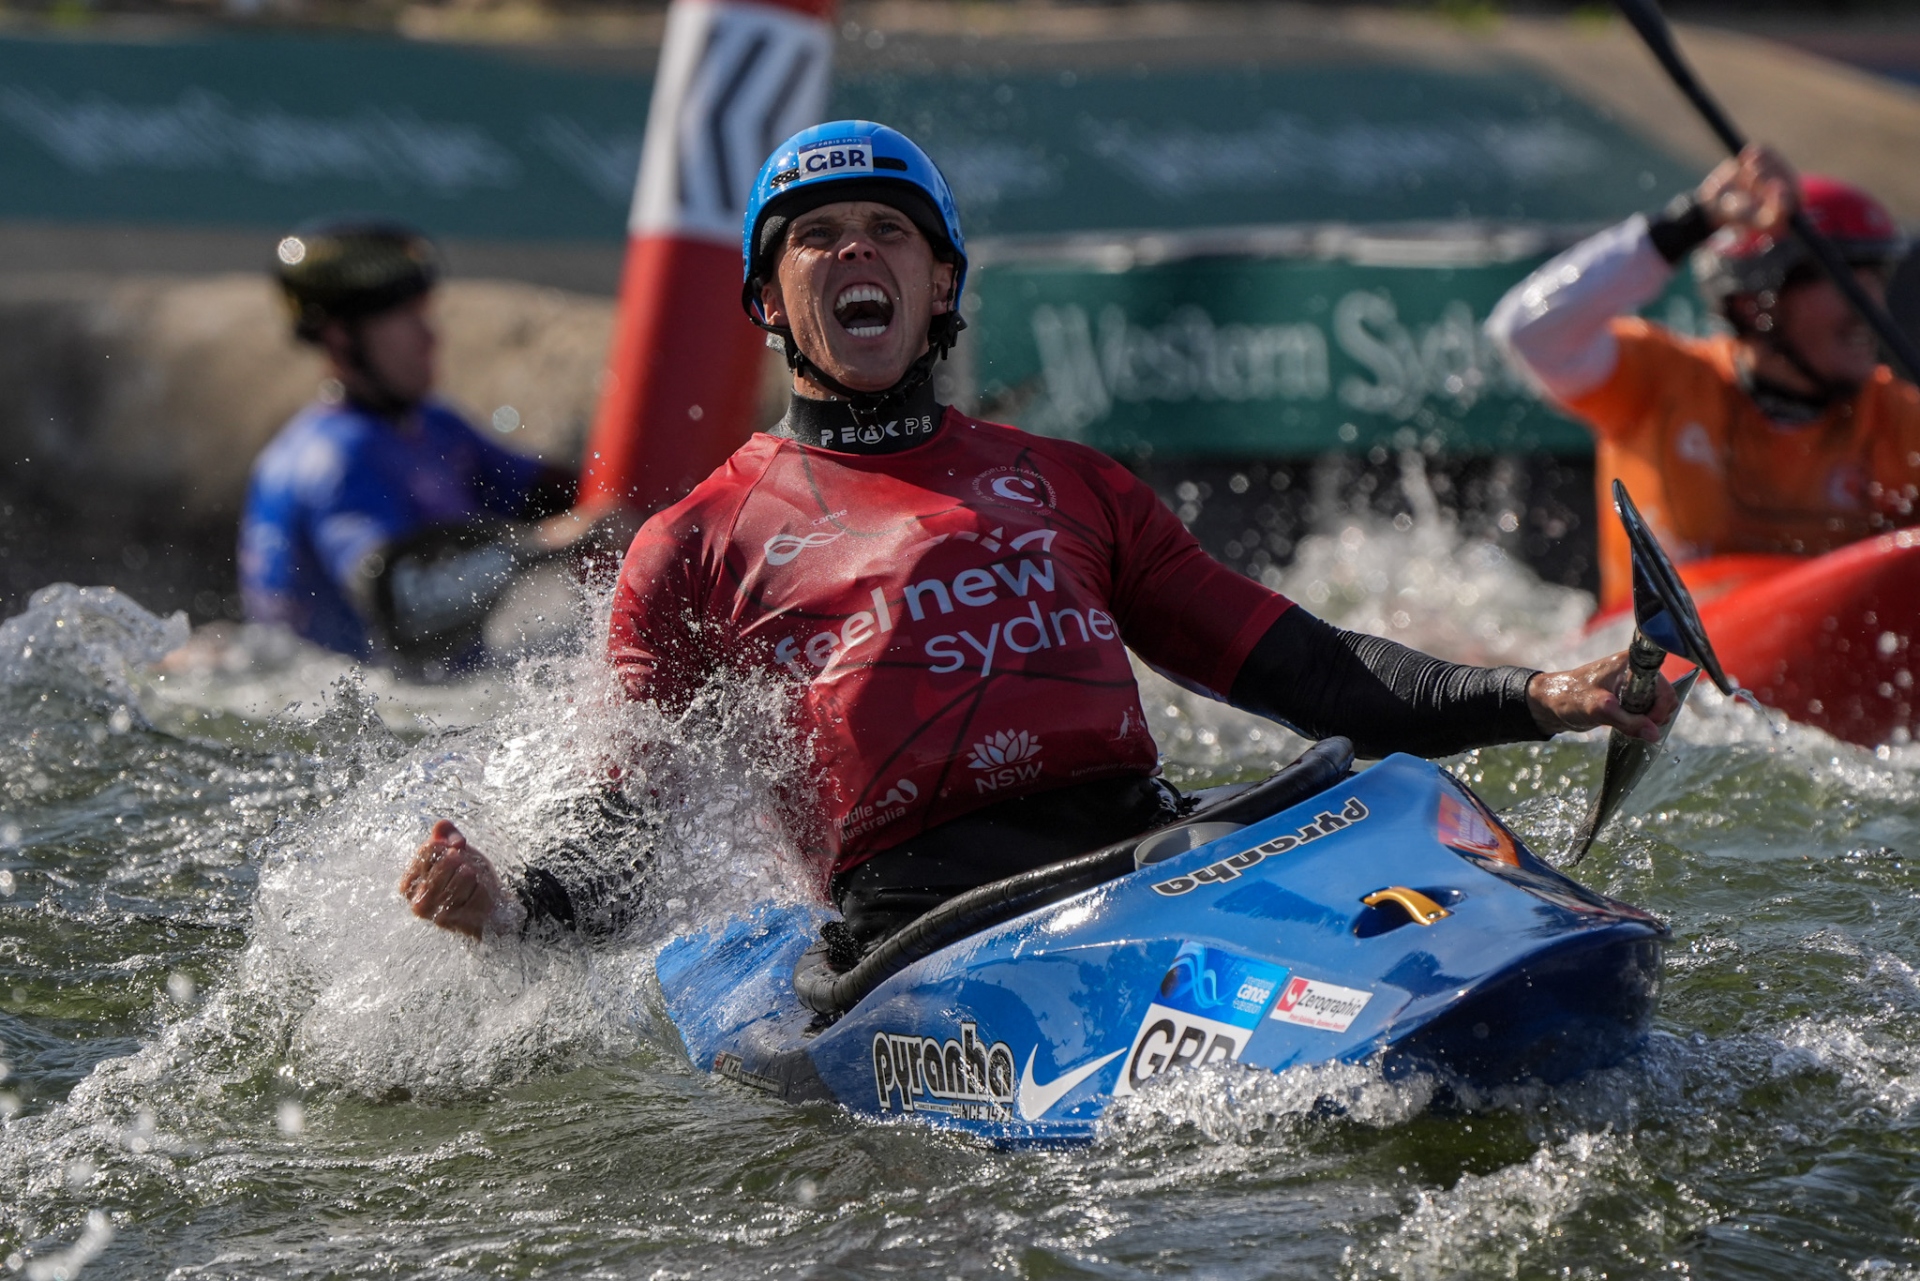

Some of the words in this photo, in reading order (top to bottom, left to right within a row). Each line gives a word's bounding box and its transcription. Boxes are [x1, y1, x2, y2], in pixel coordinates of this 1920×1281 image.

[805, 149, 866, 172] GBR
[811, 509, 848, 526] canoe
[774, 586, 893, 680] feel
[903, 559, 1055, 621] new
[924, 600, 1117, 678] sydne
[975, 761, 1043, 794] NSW
[840, 806, 906, 843] Australia
[1150, 796, 1370, 896] pyranha
[1236, 983, 1271, 1004] canoe
[1297, 988, 1361, 1018] Zerographic
[873, 1021, 1015, 1112] pyranha
